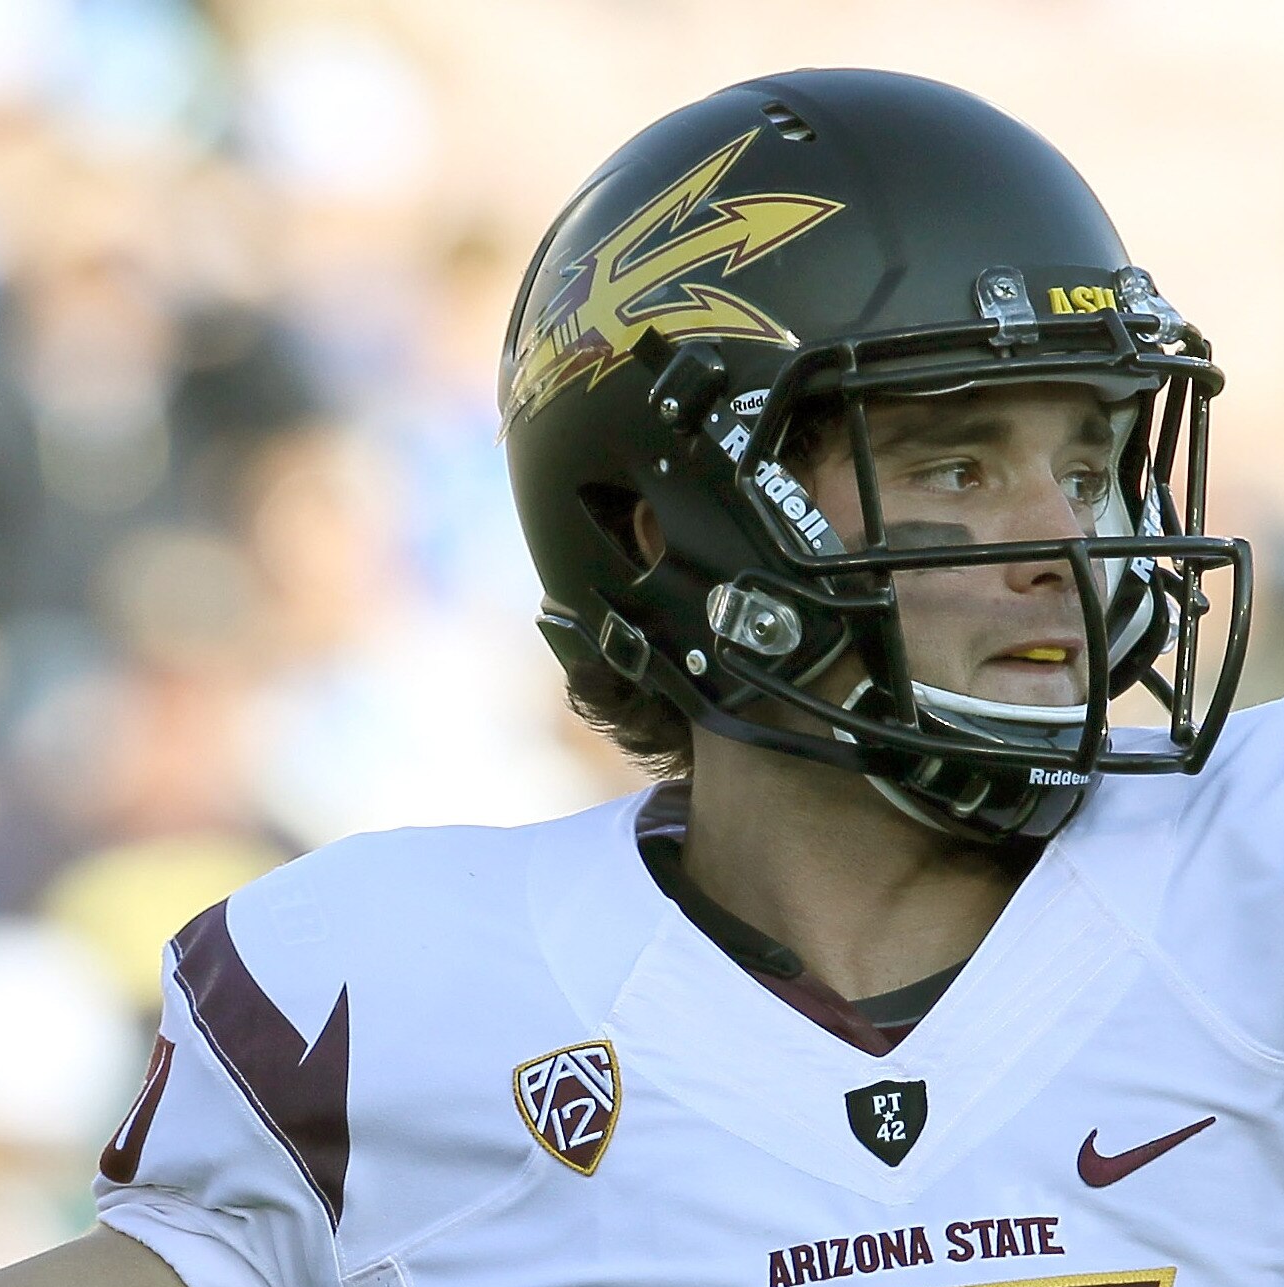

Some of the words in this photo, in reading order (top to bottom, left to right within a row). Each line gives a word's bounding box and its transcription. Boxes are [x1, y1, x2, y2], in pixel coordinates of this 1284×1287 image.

[1047, 286, 1118, 315] ASU
[733, 395, 764, 412] Ridd
[719, 424, 829, 541] Rddell
[520, 1047, 613, 1134] PAC
[872, 1092, 902, 1115] PT
[551, 1098, 604, 1151] 12
[876, 1120, 907, 1142] 42
[945, 1217, 1065, 1262] STATE
